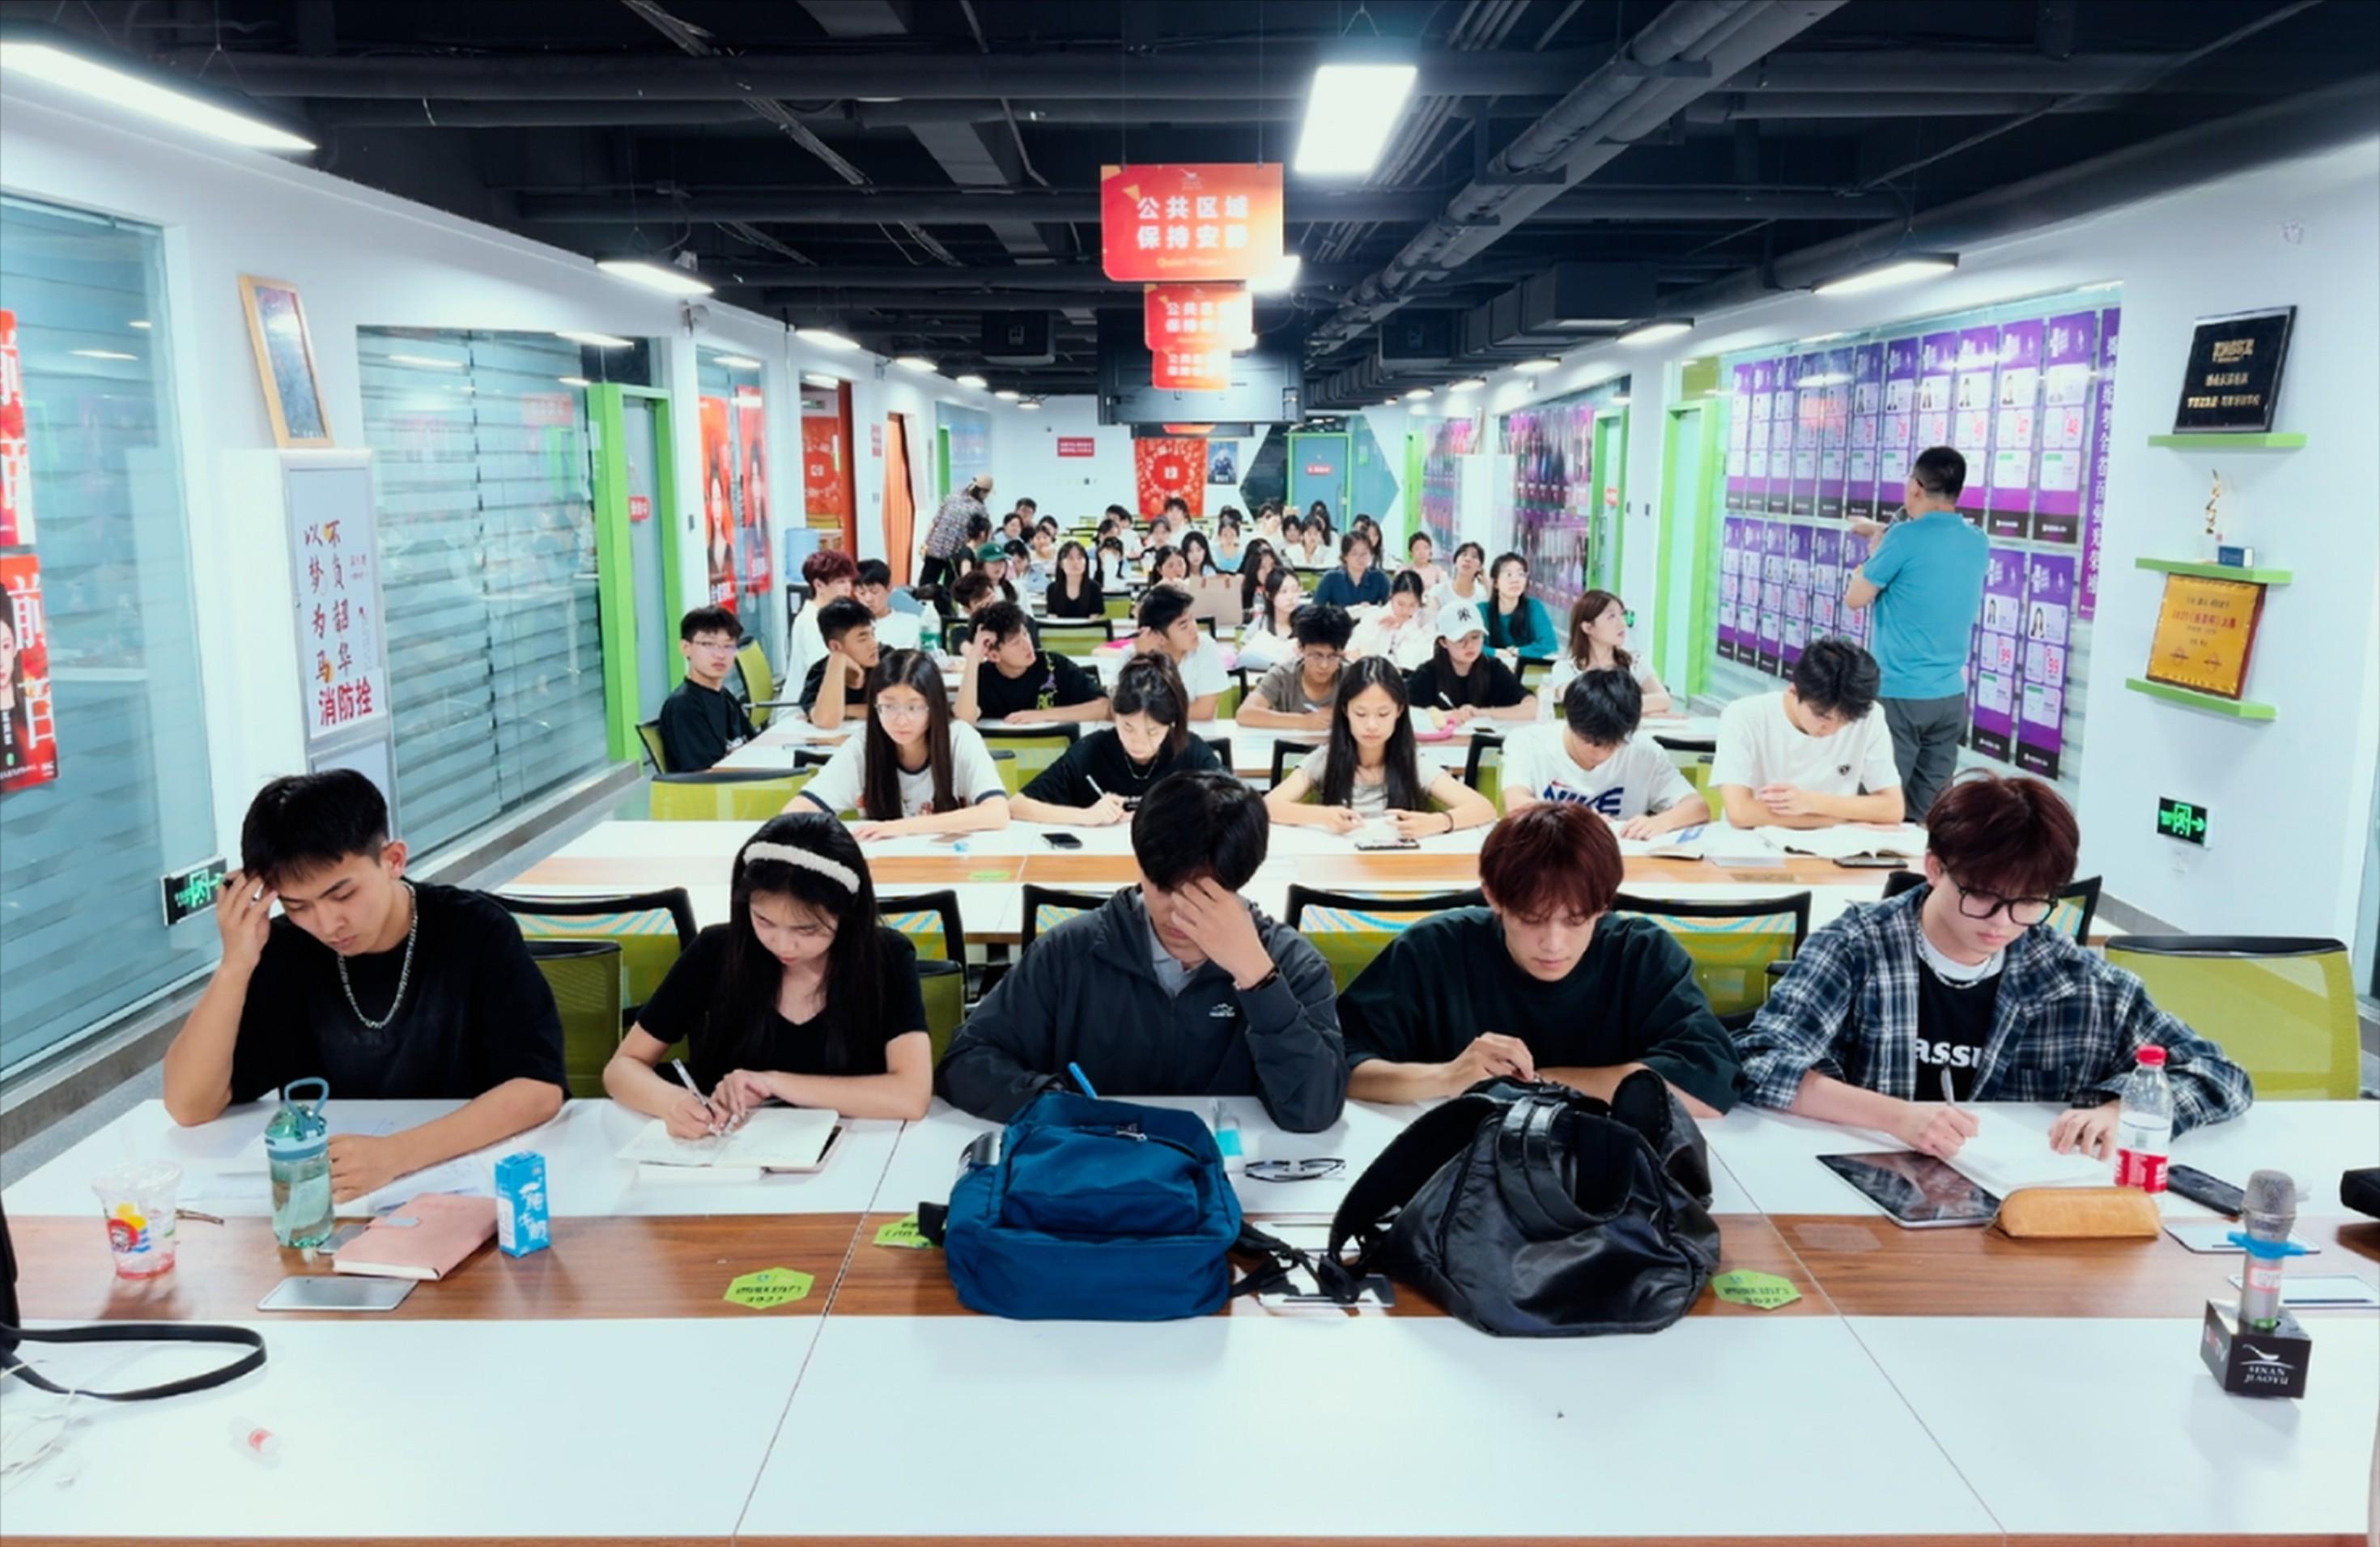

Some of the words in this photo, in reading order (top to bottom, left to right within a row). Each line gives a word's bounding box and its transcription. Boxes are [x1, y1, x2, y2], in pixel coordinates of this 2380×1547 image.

[1137, 225, 1248, 249] 保持安
[317, 674, 373, 728] 消防栓
